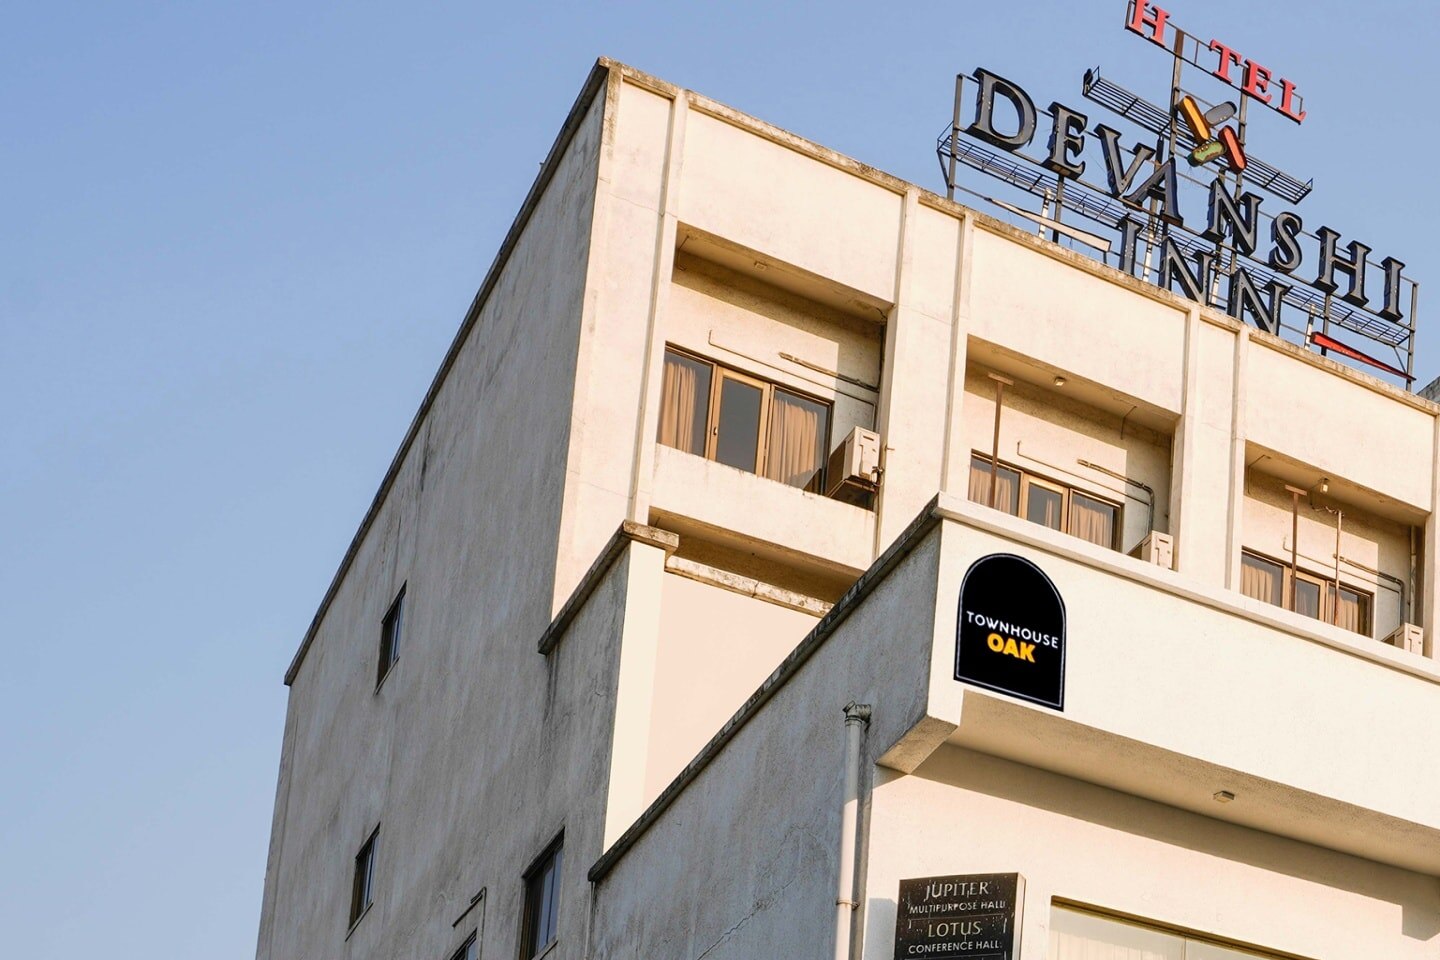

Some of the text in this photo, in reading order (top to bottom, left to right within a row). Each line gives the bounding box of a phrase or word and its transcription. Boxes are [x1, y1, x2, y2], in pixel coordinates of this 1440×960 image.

[1130, 0, 1307, 125] HTEL
[964, 67, 1405, 323] DEVANSHI
[1116, 213, 1294, 336] INN
[966, 611, 1059, 649] TOWNHOUSE
[987, 633, 1036, 663] OAK
[924, 881, 990, 902] JUPITER
[909, 900, 1005, 914] MULTIPURPOSE HALL
[928, 920, 982, 938] LOTUS
[908, 940, 1000, 954] CONFERENCE HALL
